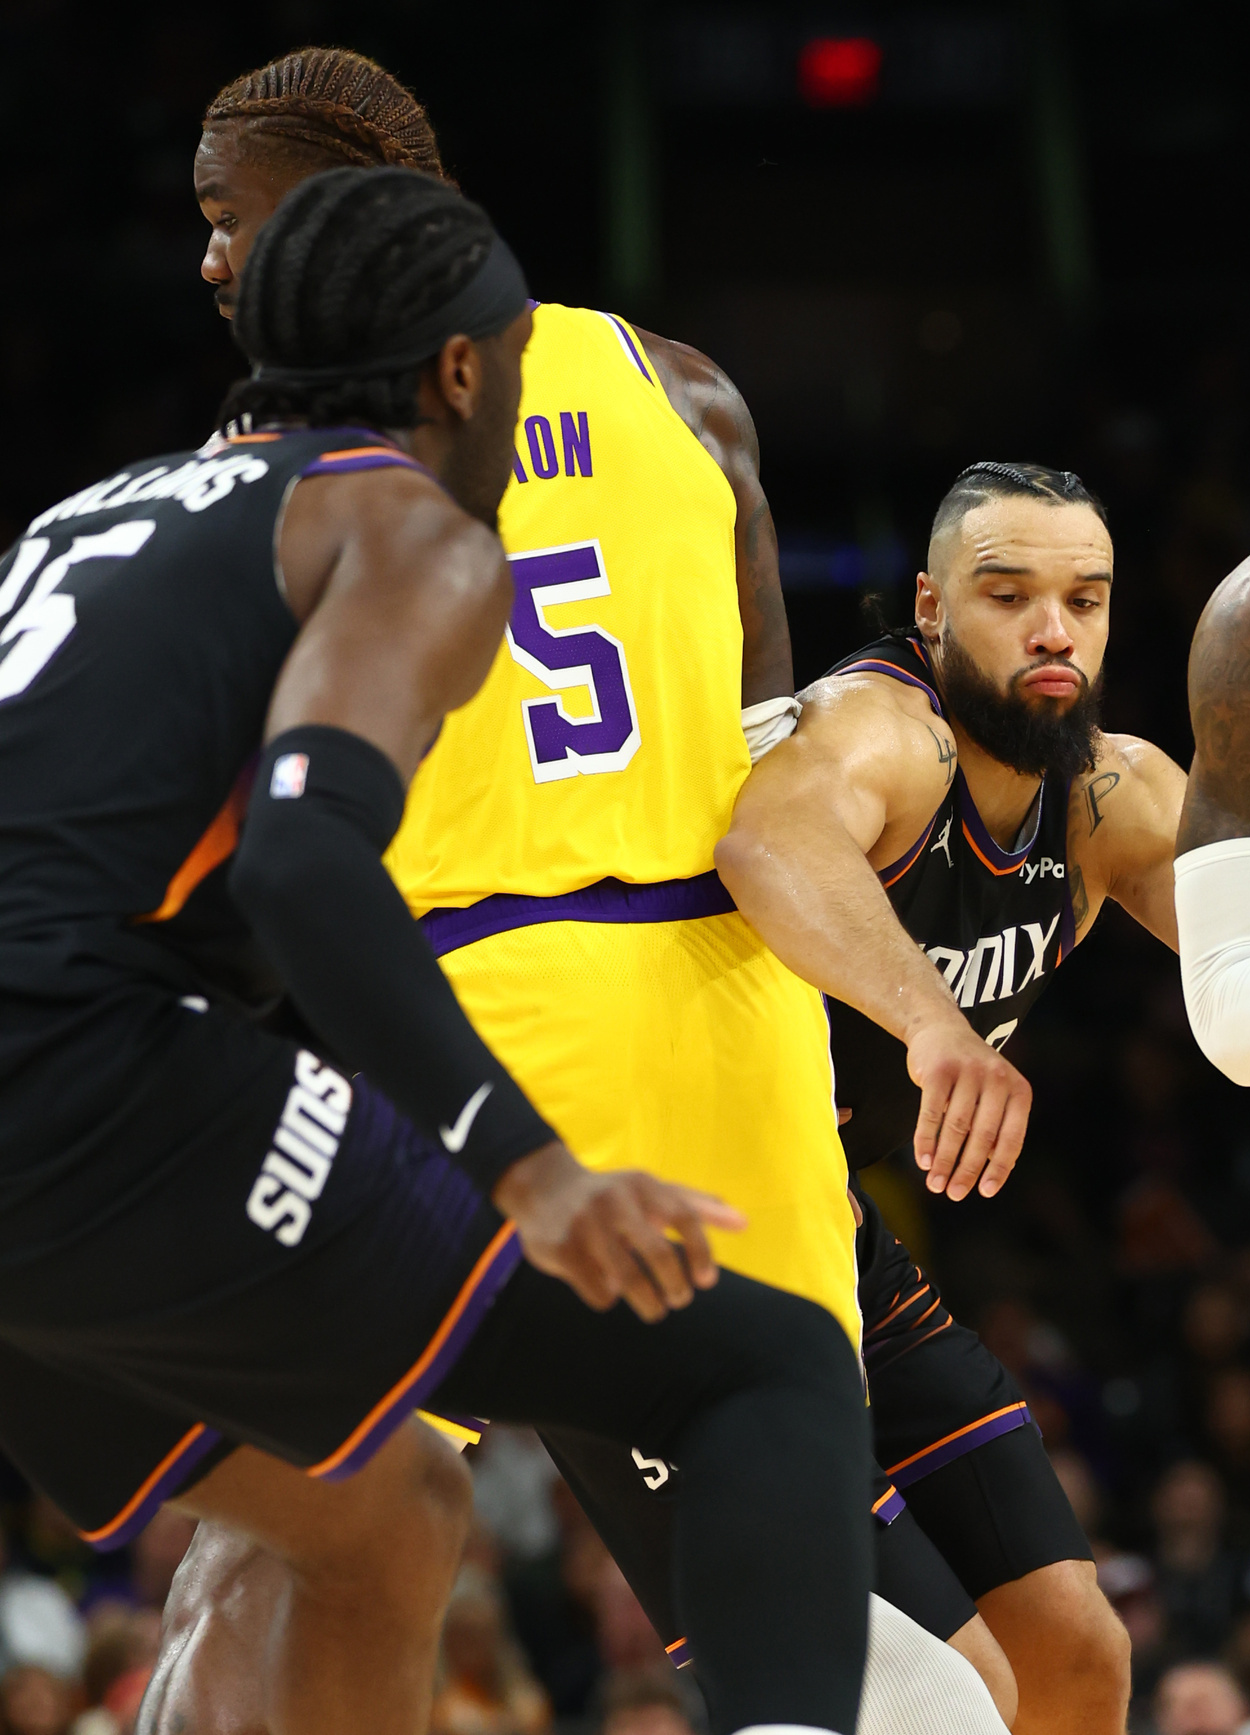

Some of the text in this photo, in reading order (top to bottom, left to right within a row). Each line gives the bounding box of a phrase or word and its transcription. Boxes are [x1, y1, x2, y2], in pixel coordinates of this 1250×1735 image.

[506, 538, 642, 784] 5
[1018, 856, 1065, 885] yPa
[246, 1049, 353, 1248] SUNS
